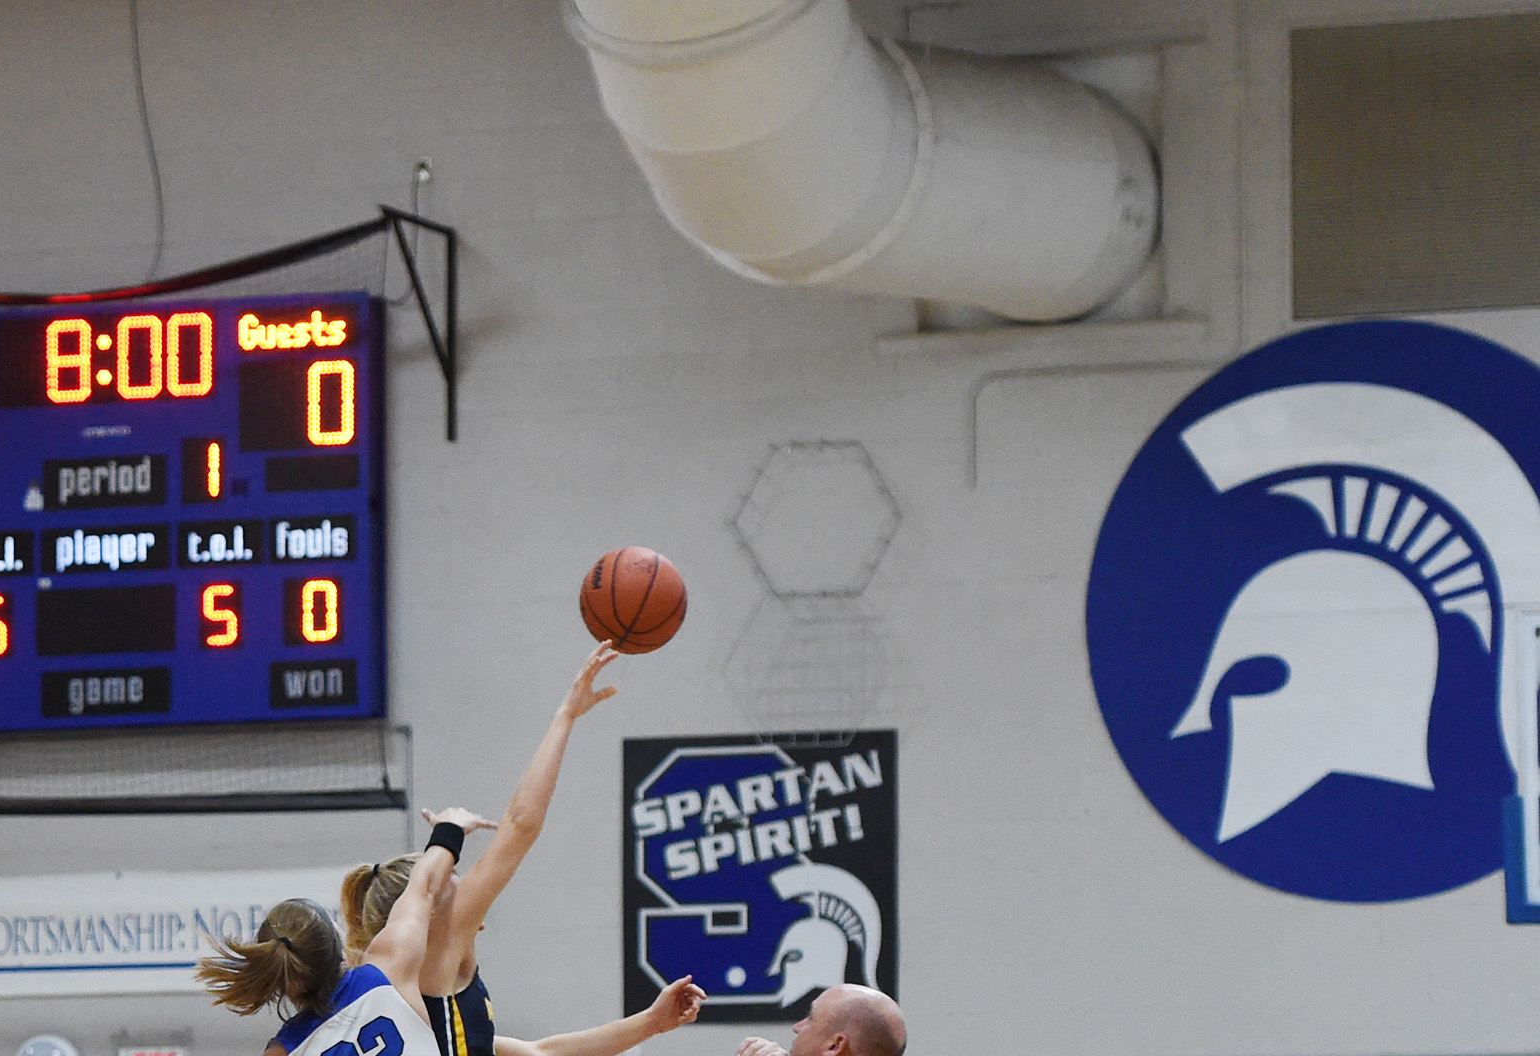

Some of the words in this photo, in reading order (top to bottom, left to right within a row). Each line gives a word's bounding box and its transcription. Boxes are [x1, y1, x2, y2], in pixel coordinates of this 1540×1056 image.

[45, 312, 214, 404] 8:00
[237, 310, 347, 351] Guests
[306, 359, 356, 447] 0
[58, 457, 152, 505] period
[206, 441, 222, 498] 1
[56, 529, 156, 572] player
[187, 527, 253, 562] t.o.l.
[274, 519, 349, 559] fouls
[201, 583, 240, 648] 5
[301, 578, 339, 644] 0
[67, 674, 145, 713] game
[284, 667, 345, 700] won
[632, 750, 883, 837] SPARTAN
[663, 803, 864, 880] SPIRIT!
